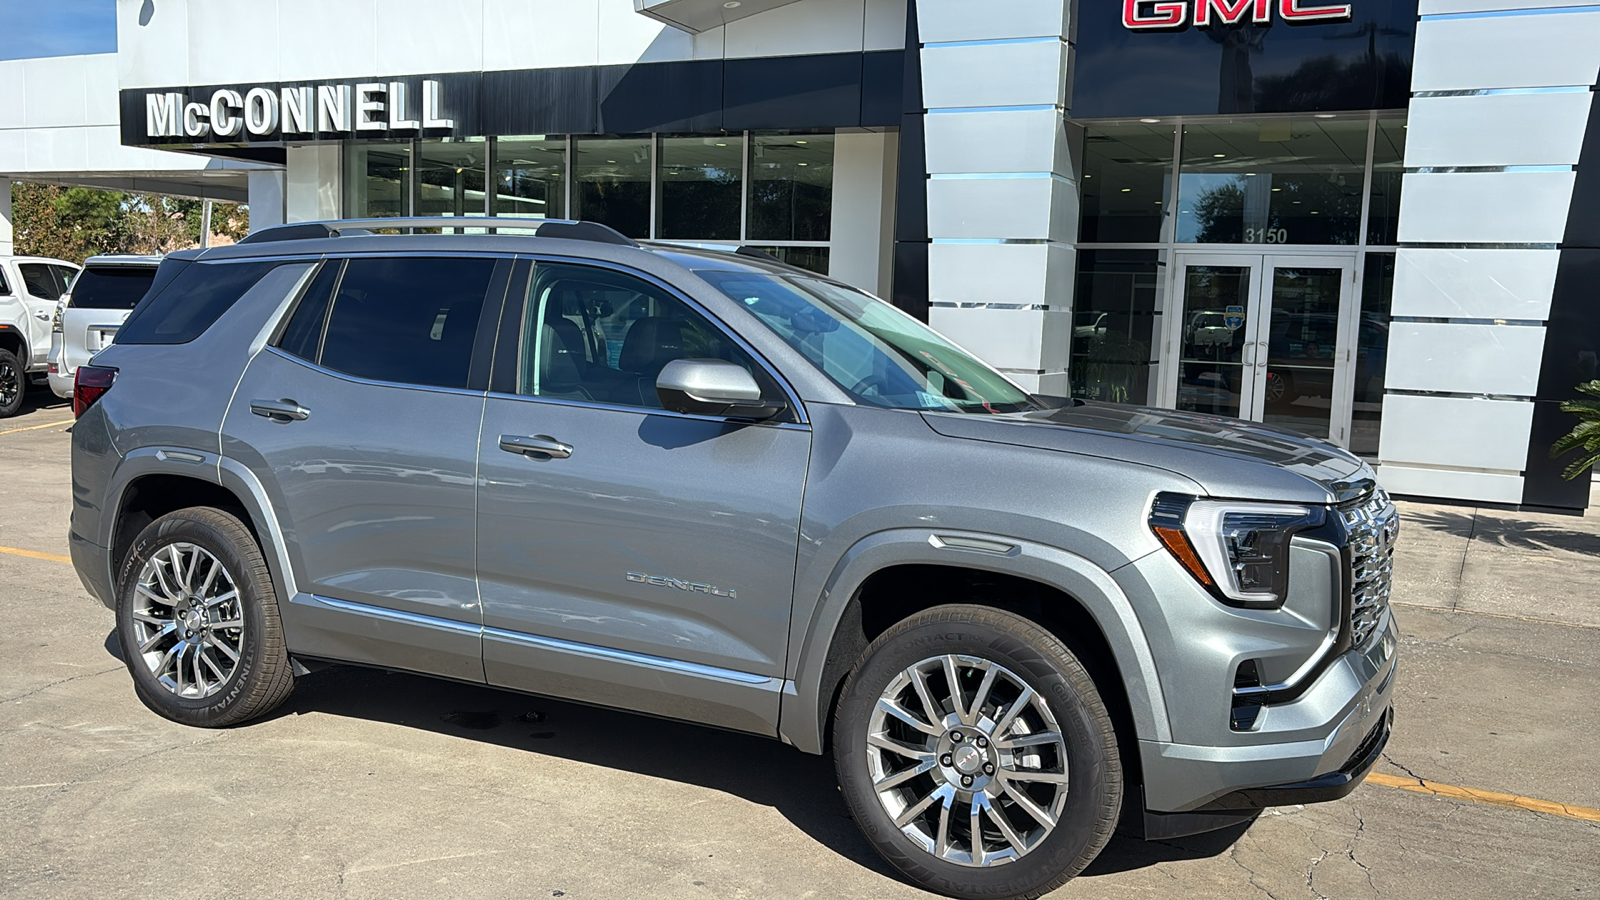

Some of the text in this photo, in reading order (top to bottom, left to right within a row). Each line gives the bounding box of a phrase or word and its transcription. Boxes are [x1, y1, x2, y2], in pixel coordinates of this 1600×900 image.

[146, 80, 453, 137] McCONNELL
[1245, 228, 1288, 244] 3150
[626, 572, 737, 599] DENALI
[210, 619, 256, 713] CONTINENTAL
